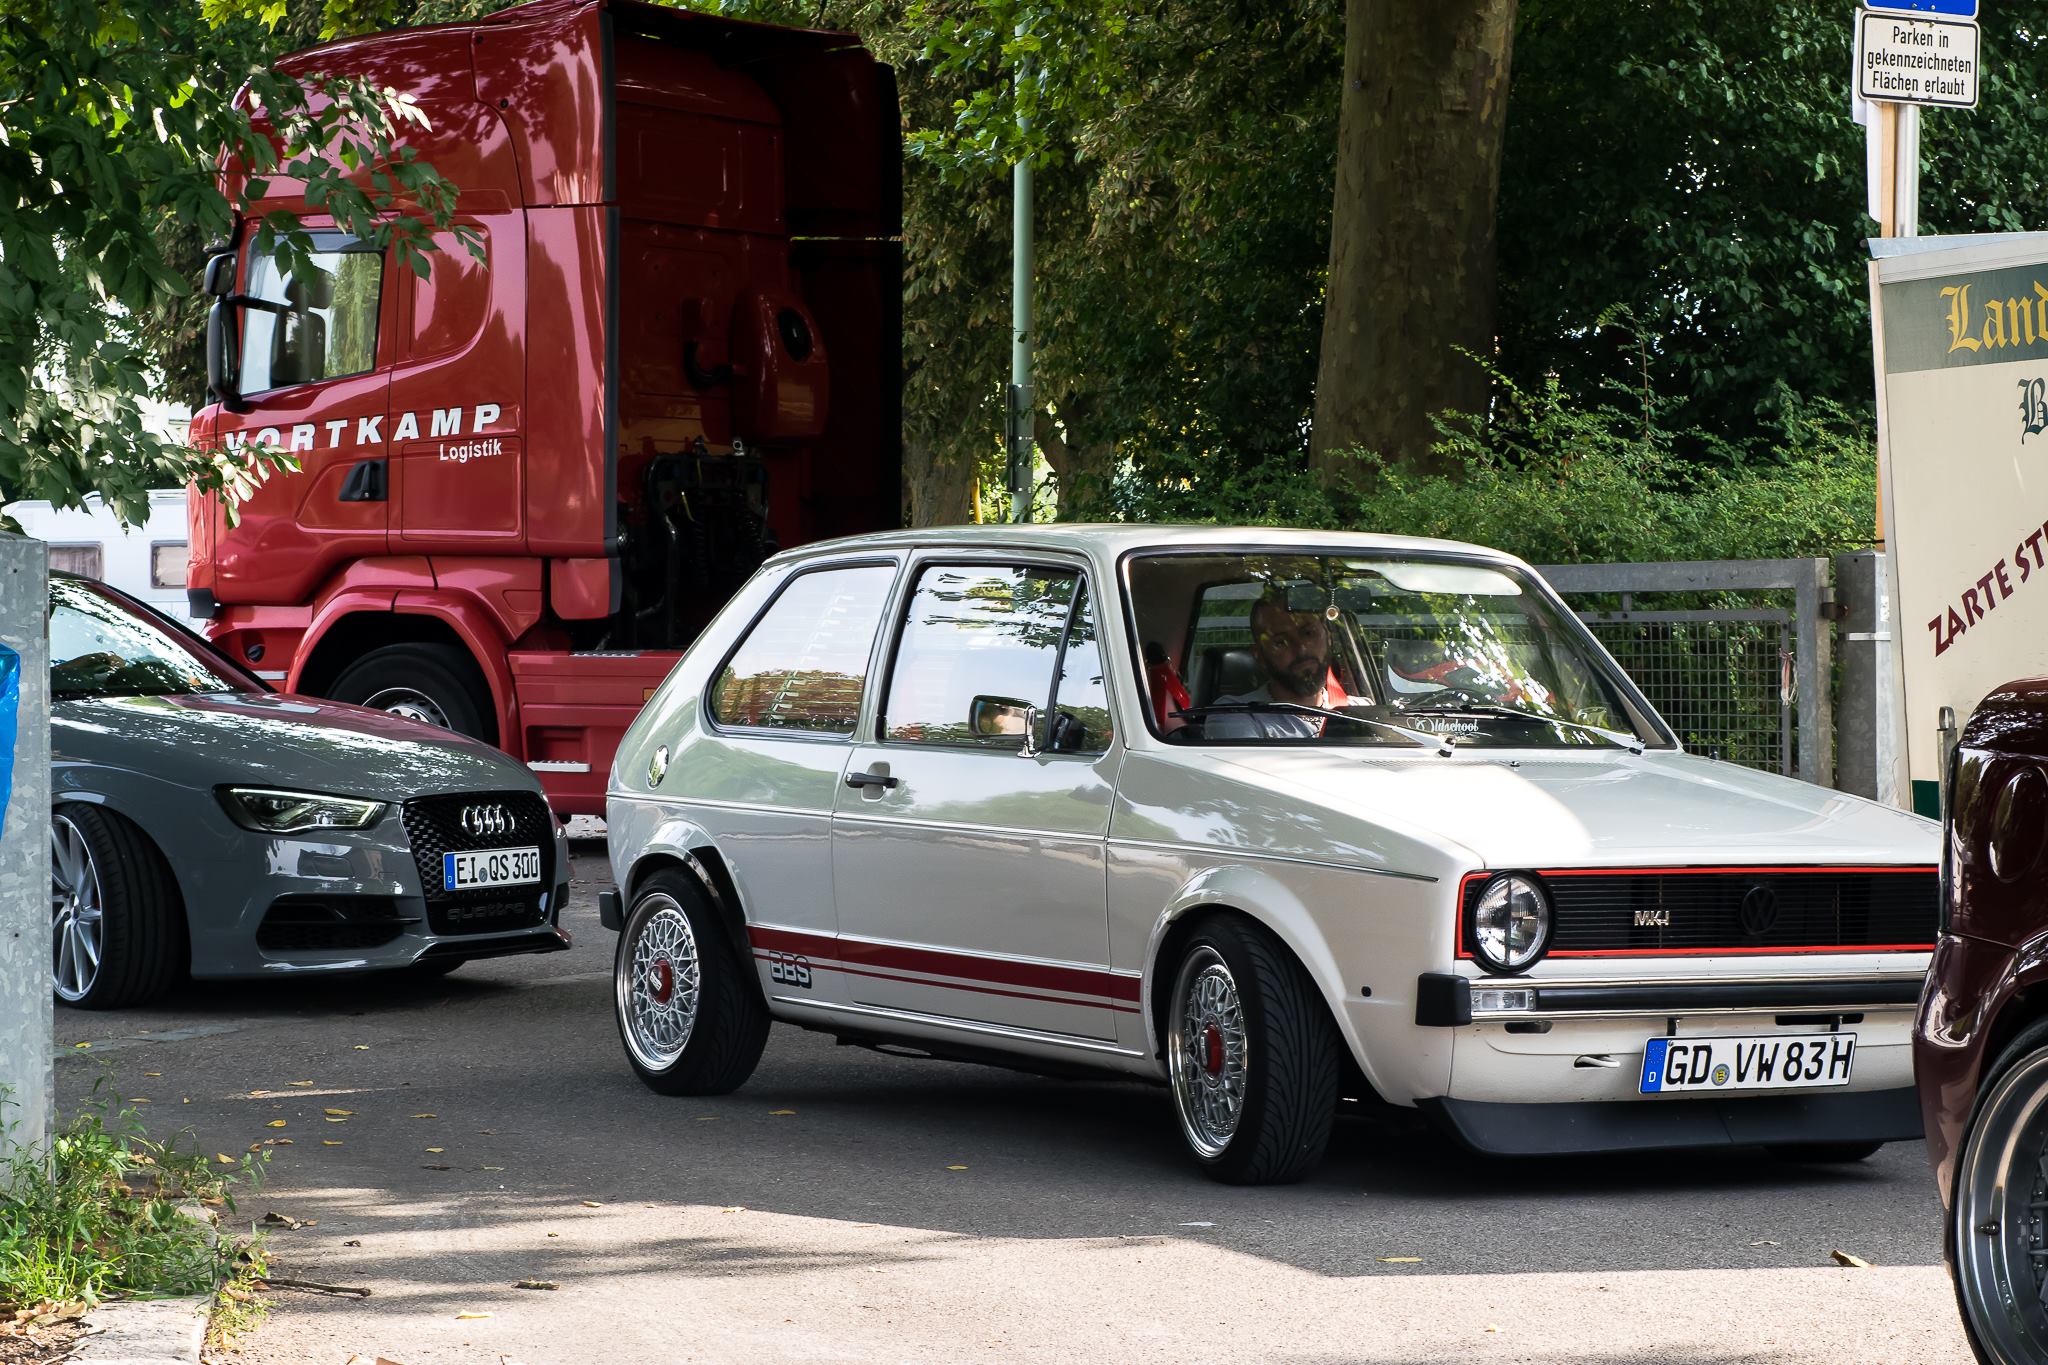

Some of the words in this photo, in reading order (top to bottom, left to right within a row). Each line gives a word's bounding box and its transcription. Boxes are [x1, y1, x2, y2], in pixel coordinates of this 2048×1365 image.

[1893, 26, 1933, 47] Parken
[1939, 30, 1949, 48] in
[1867, 48, 1971, 73] gekennzeichneten
[1872, 71, 1919, 92] Flächen
[1924, 76, 1965, 95] erlaubt
[224, 403, 501, 456] VORTKAMP
[439, 438, 502, 464] Logistik
[1927, 558, 2014, 657] ZARTE
[2015, 519, 2048, 584] ST
[456, 857, 478, 884] EI
[769, 951, 812, 989] BBS
[1648, 1071, 1657, 1083] D
[1665, 1044, 1713, 1085] GD
